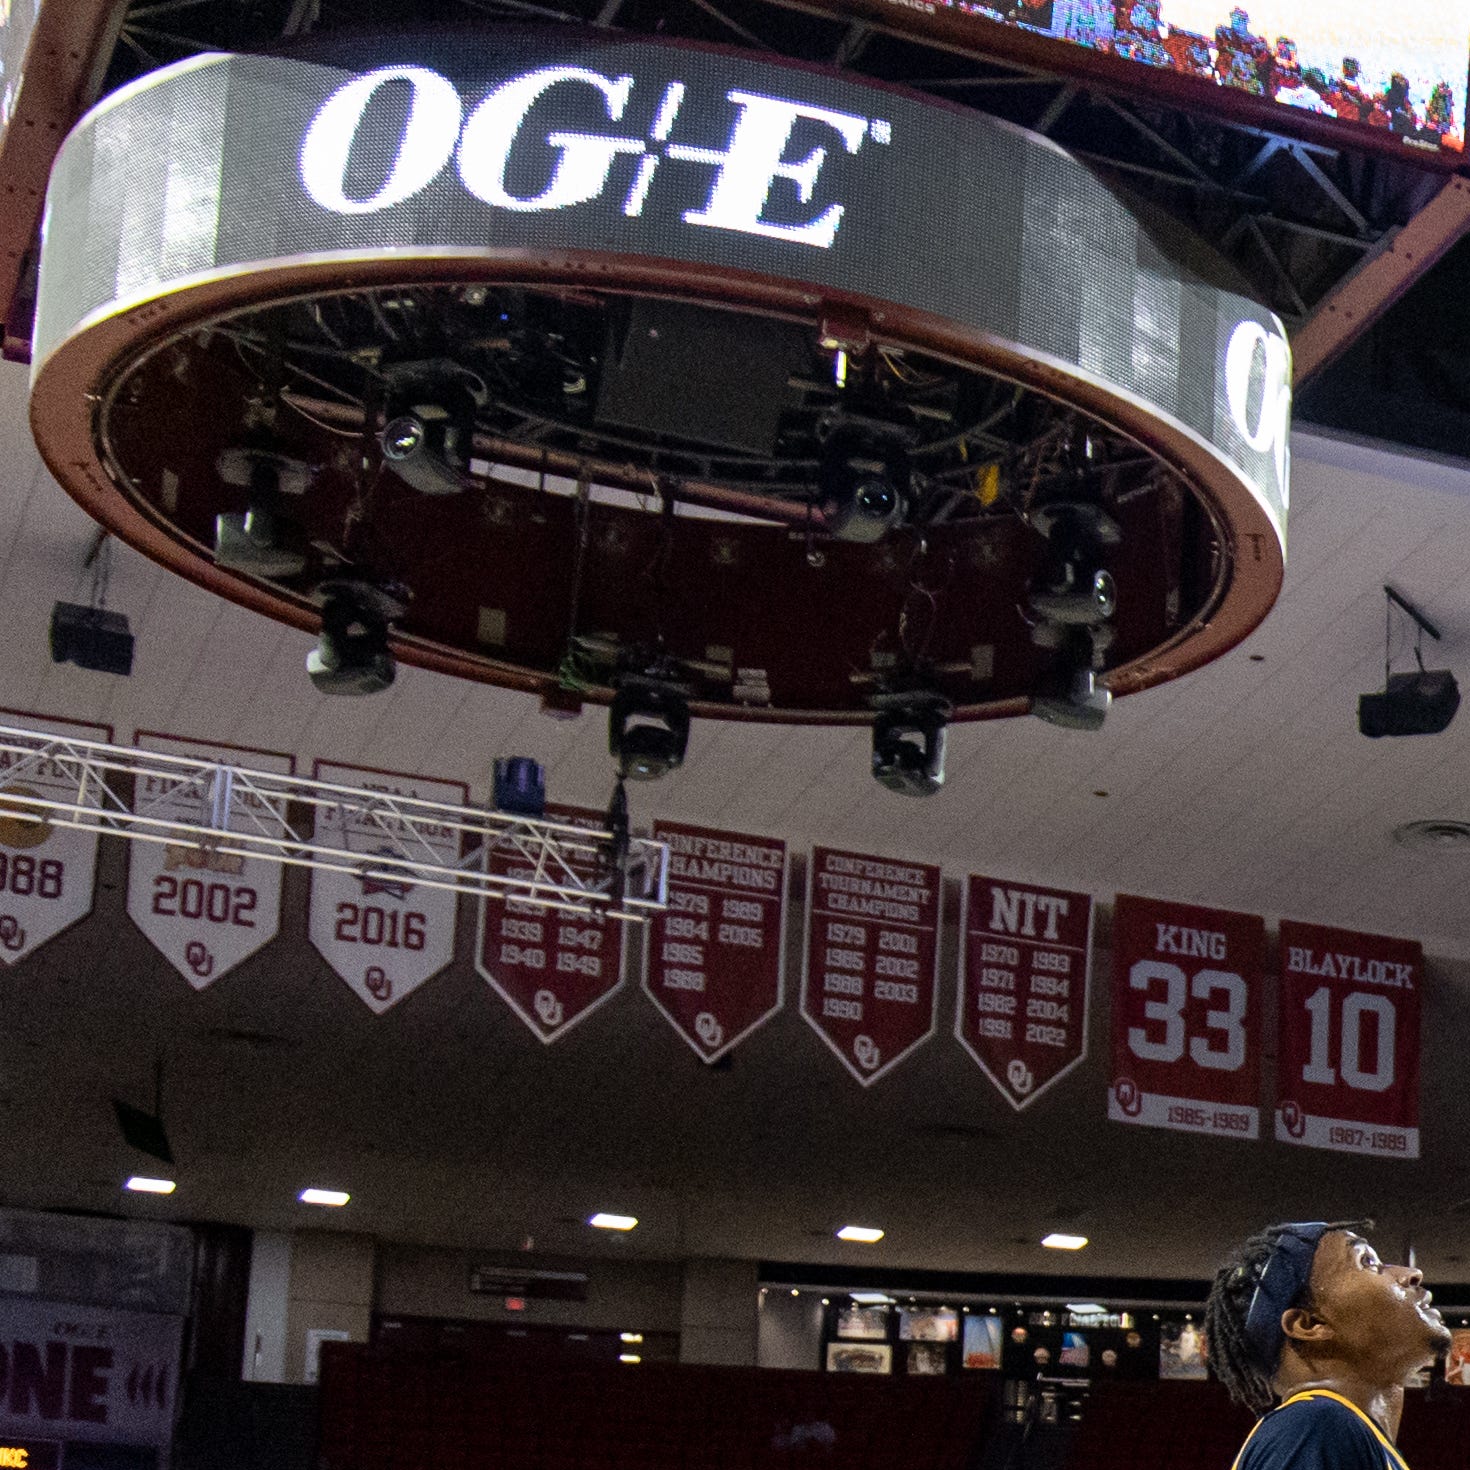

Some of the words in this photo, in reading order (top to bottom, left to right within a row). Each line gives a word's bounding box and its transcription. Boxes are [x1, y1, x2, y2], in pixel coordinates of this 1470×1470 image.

[0, 853, 63, 899] 88
[668, 854, 777, 889] HAMPIONS
[818, 872, 931, 905] TOURNAMENT
[825, 855, 926, 885] CONFERENCE
[153, 875, 257, 926] 2002
[828, 893, 920, 922] CHAMPIONS
[988, 887, 1069, 940] NIT
[335, 902, 426, 951] 2016
[1155, 923, 1227, 960] KING
[1287, 947, 1415, 989] BLAYLOCK
[1128, 959, 1247, 1072] 33
[1302, 986, 1396, 1092] 10
[0, 1338, 114, 1424] NE
